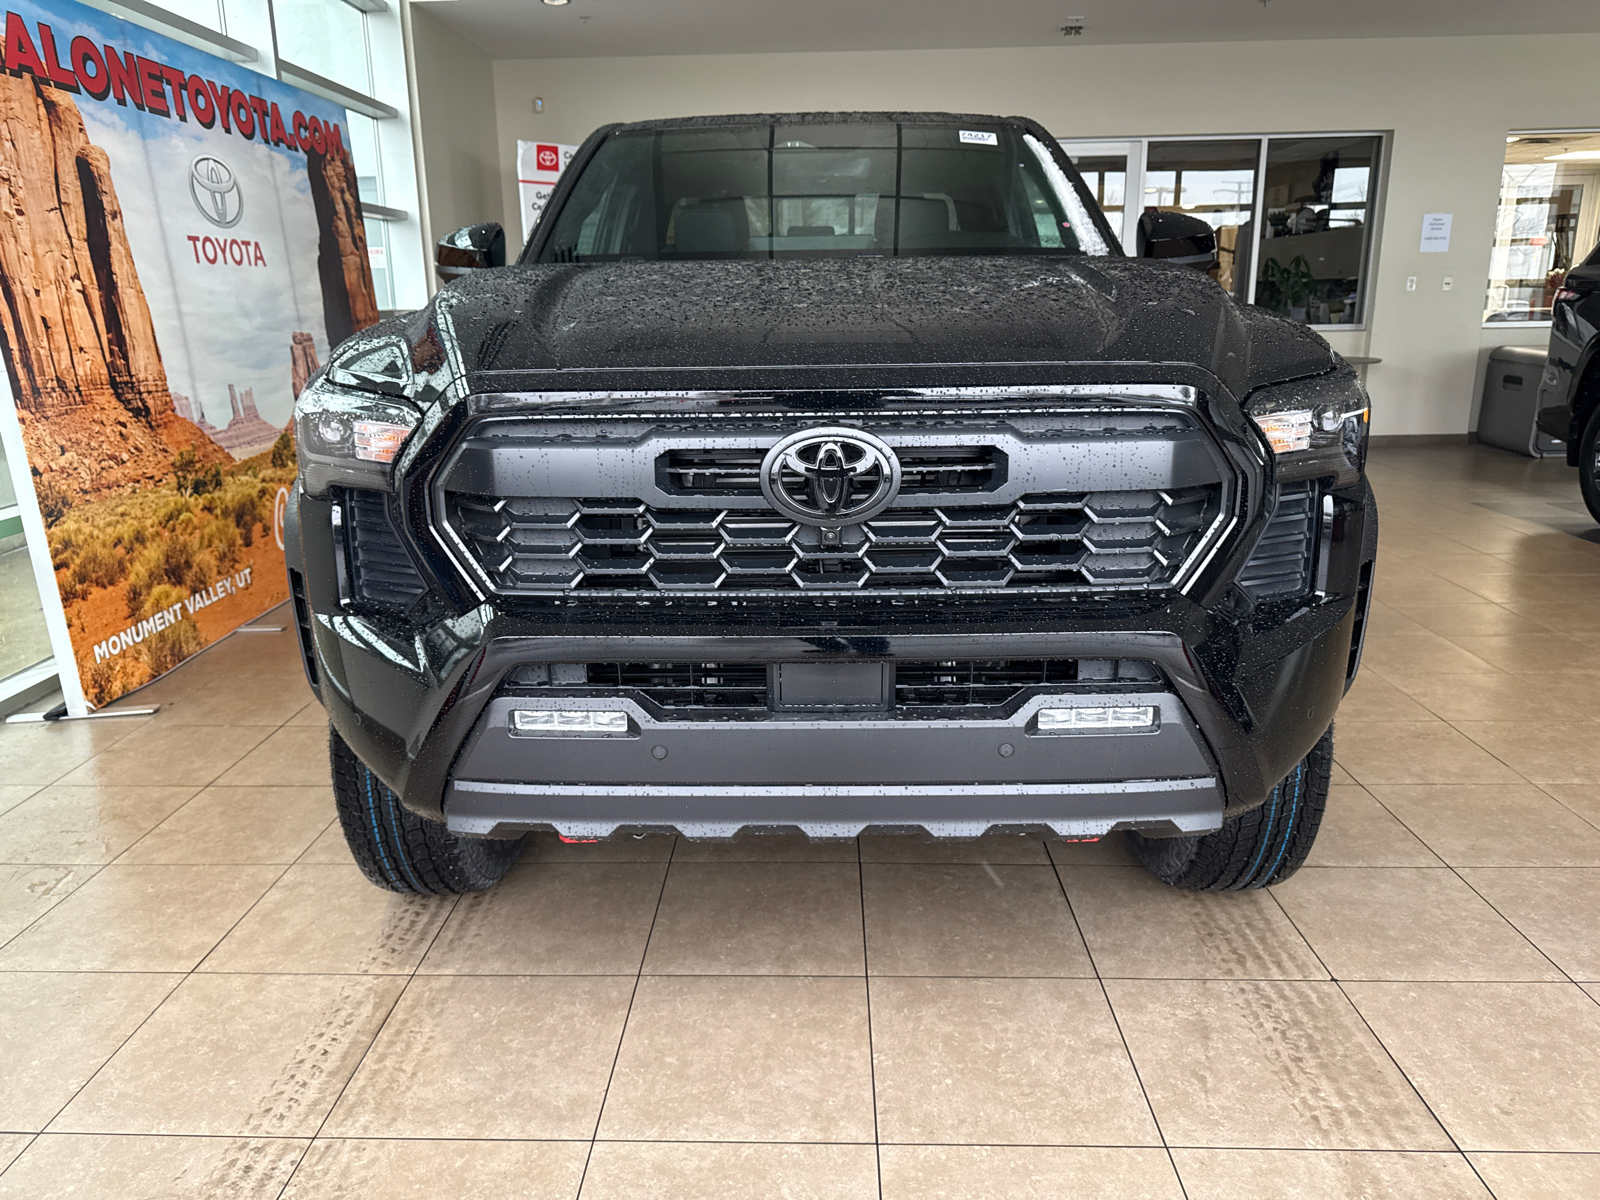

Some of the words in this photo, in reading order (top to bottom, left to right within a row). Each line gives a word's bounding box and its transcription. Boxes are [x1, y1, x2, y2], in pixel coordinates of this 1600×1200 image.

[0, 10, 346, 159] ALONETOYOTA.COM
[187, 235, 267, 267] TOYOTA
[93, 603, 183, 665] MONUMENT
[184, 577, 236, 615] VALLEY,
[235, 567, 252, 588] UT
